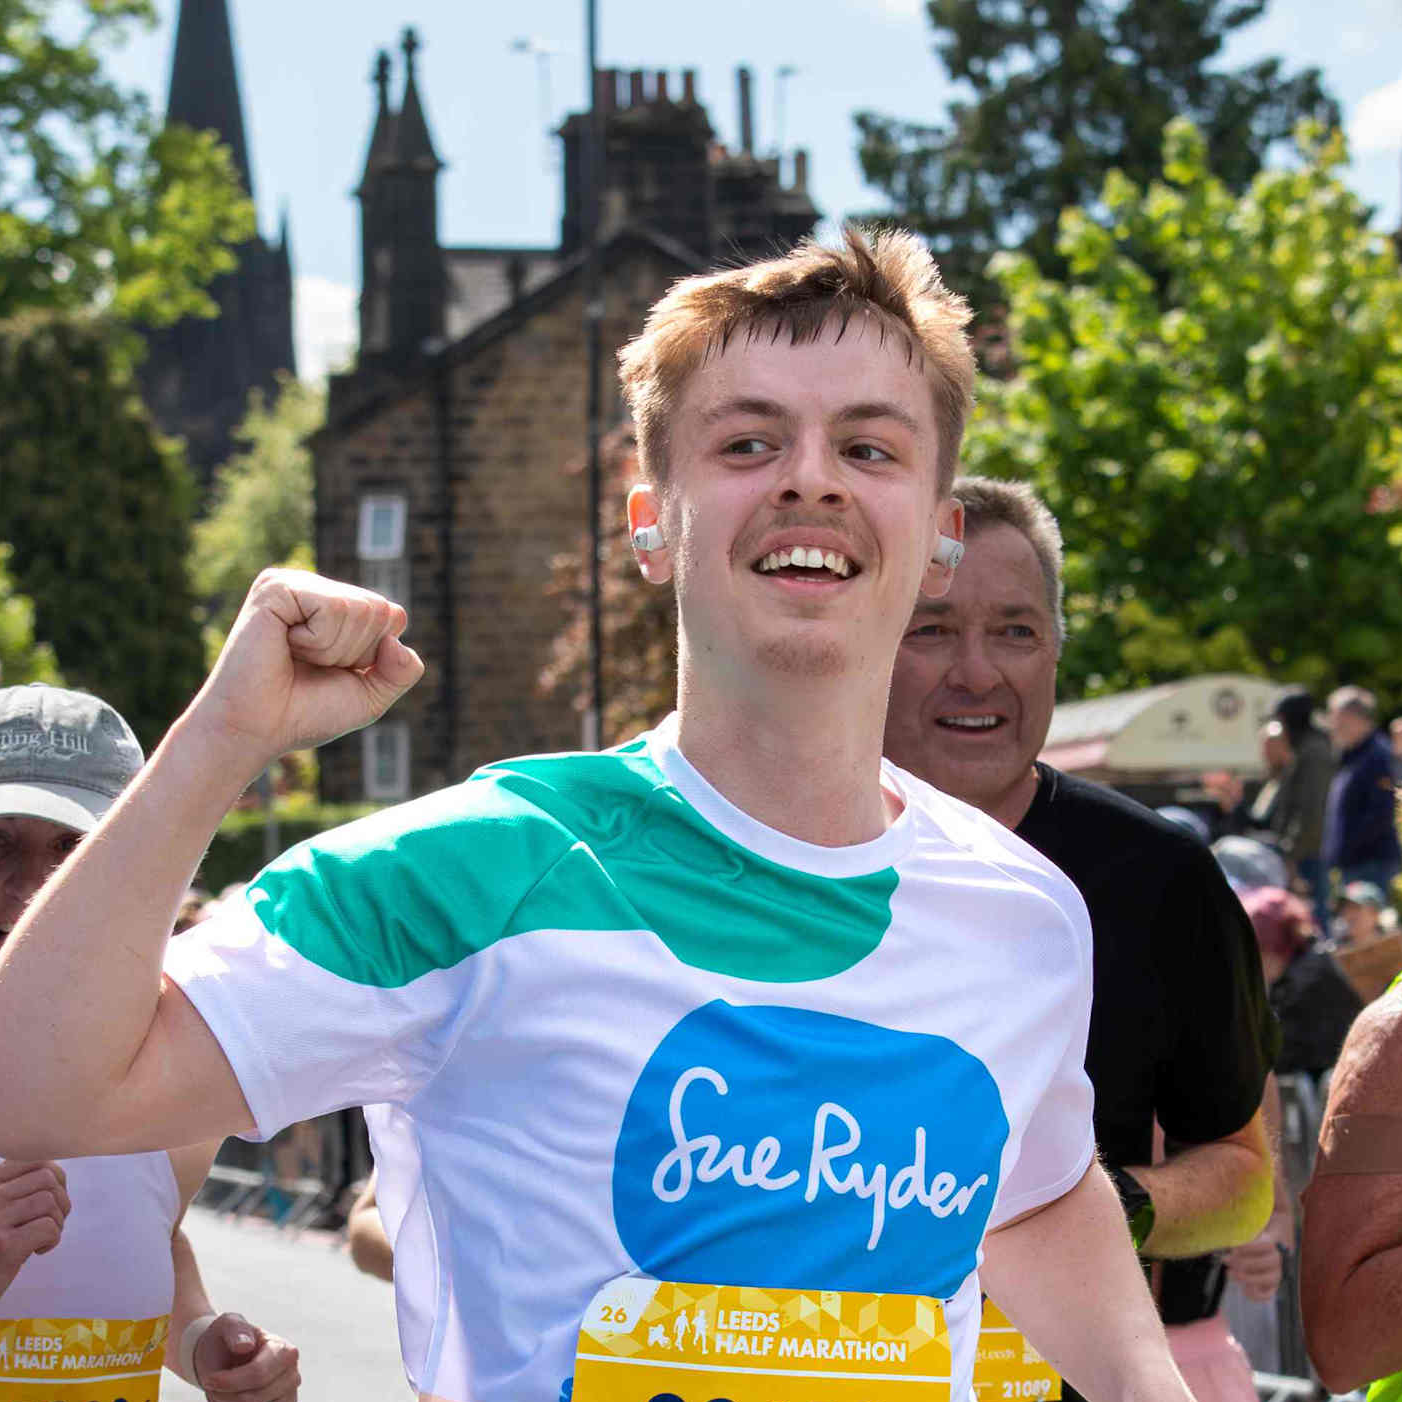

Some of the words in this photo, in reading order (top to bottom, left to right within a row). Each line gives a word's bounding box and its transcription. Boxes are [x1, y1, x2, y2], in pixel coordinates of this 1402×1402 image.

[50, 729, 92, 755] Hill
[651, 1065, 800, 1203] Sue
[804, 1101, 989, 1251] Ryder
[600, 1304, 628, 1324] 26
[717, 1309, 781, 1333] LEEDS
[15, 1335, 63, 1353] LEEDS
[714, 1332, 775, 1357] HALF
[777, 1336, 907, 1363] MARATHON
[13, 1351, 58, 1370] HALF
[61, 1351, 144, 1370] MARATHON
